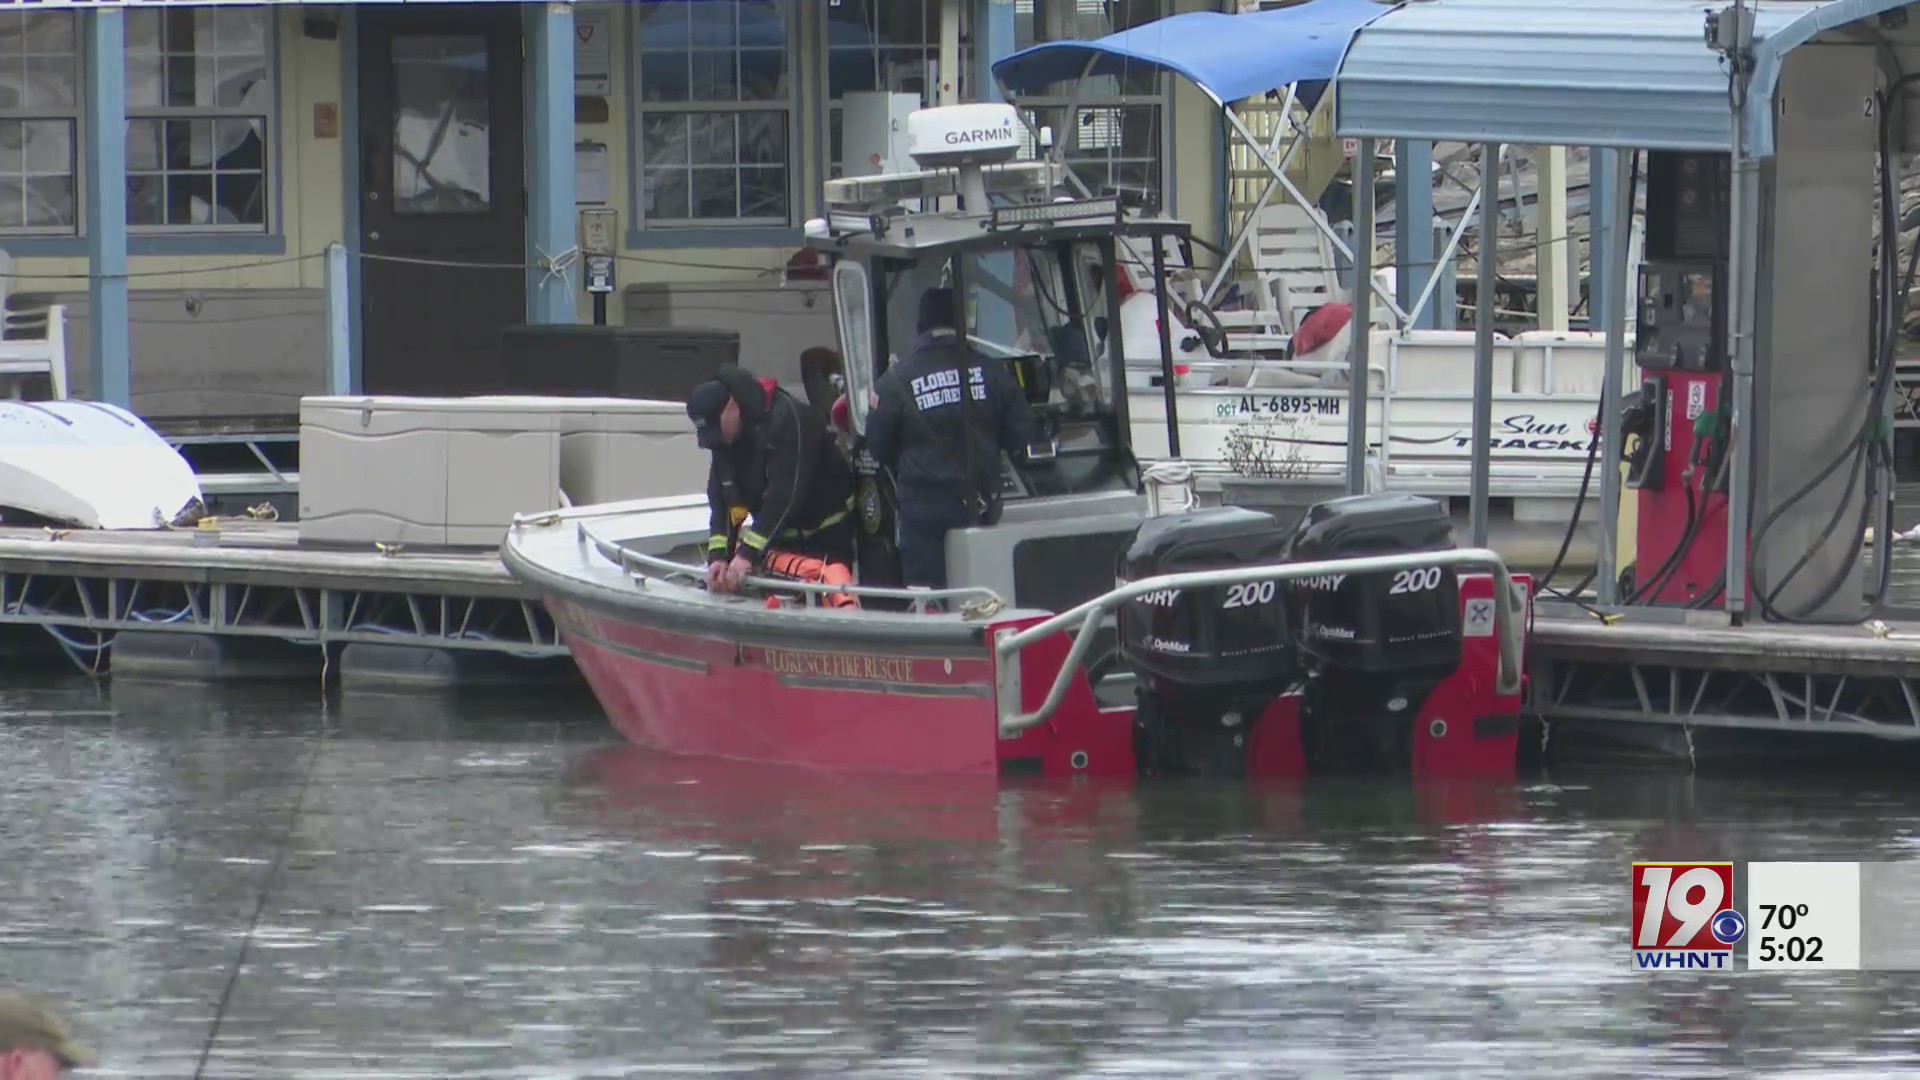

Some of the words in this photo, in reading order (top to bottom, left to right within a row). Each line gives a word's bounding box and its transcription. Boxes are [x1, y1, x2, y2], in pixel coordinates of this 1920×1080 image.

[1865, 97, 1873, 117] 2
[945, 128, 1012, 145] GARMIN
[1217, 404, 1237, 416] OCT
[1240, 395, 1340, 415] AL-6895-MH
[1499, 414, 1570, 436] Sun
[1389, 566, 1442, 595] 200
[1222, 580, 1276, 609] 200
[764, 649, 831, 676] FLORENCE
[832, 655, 863, 677] FIRE
[863, 657, 914, 682] RESCUE
